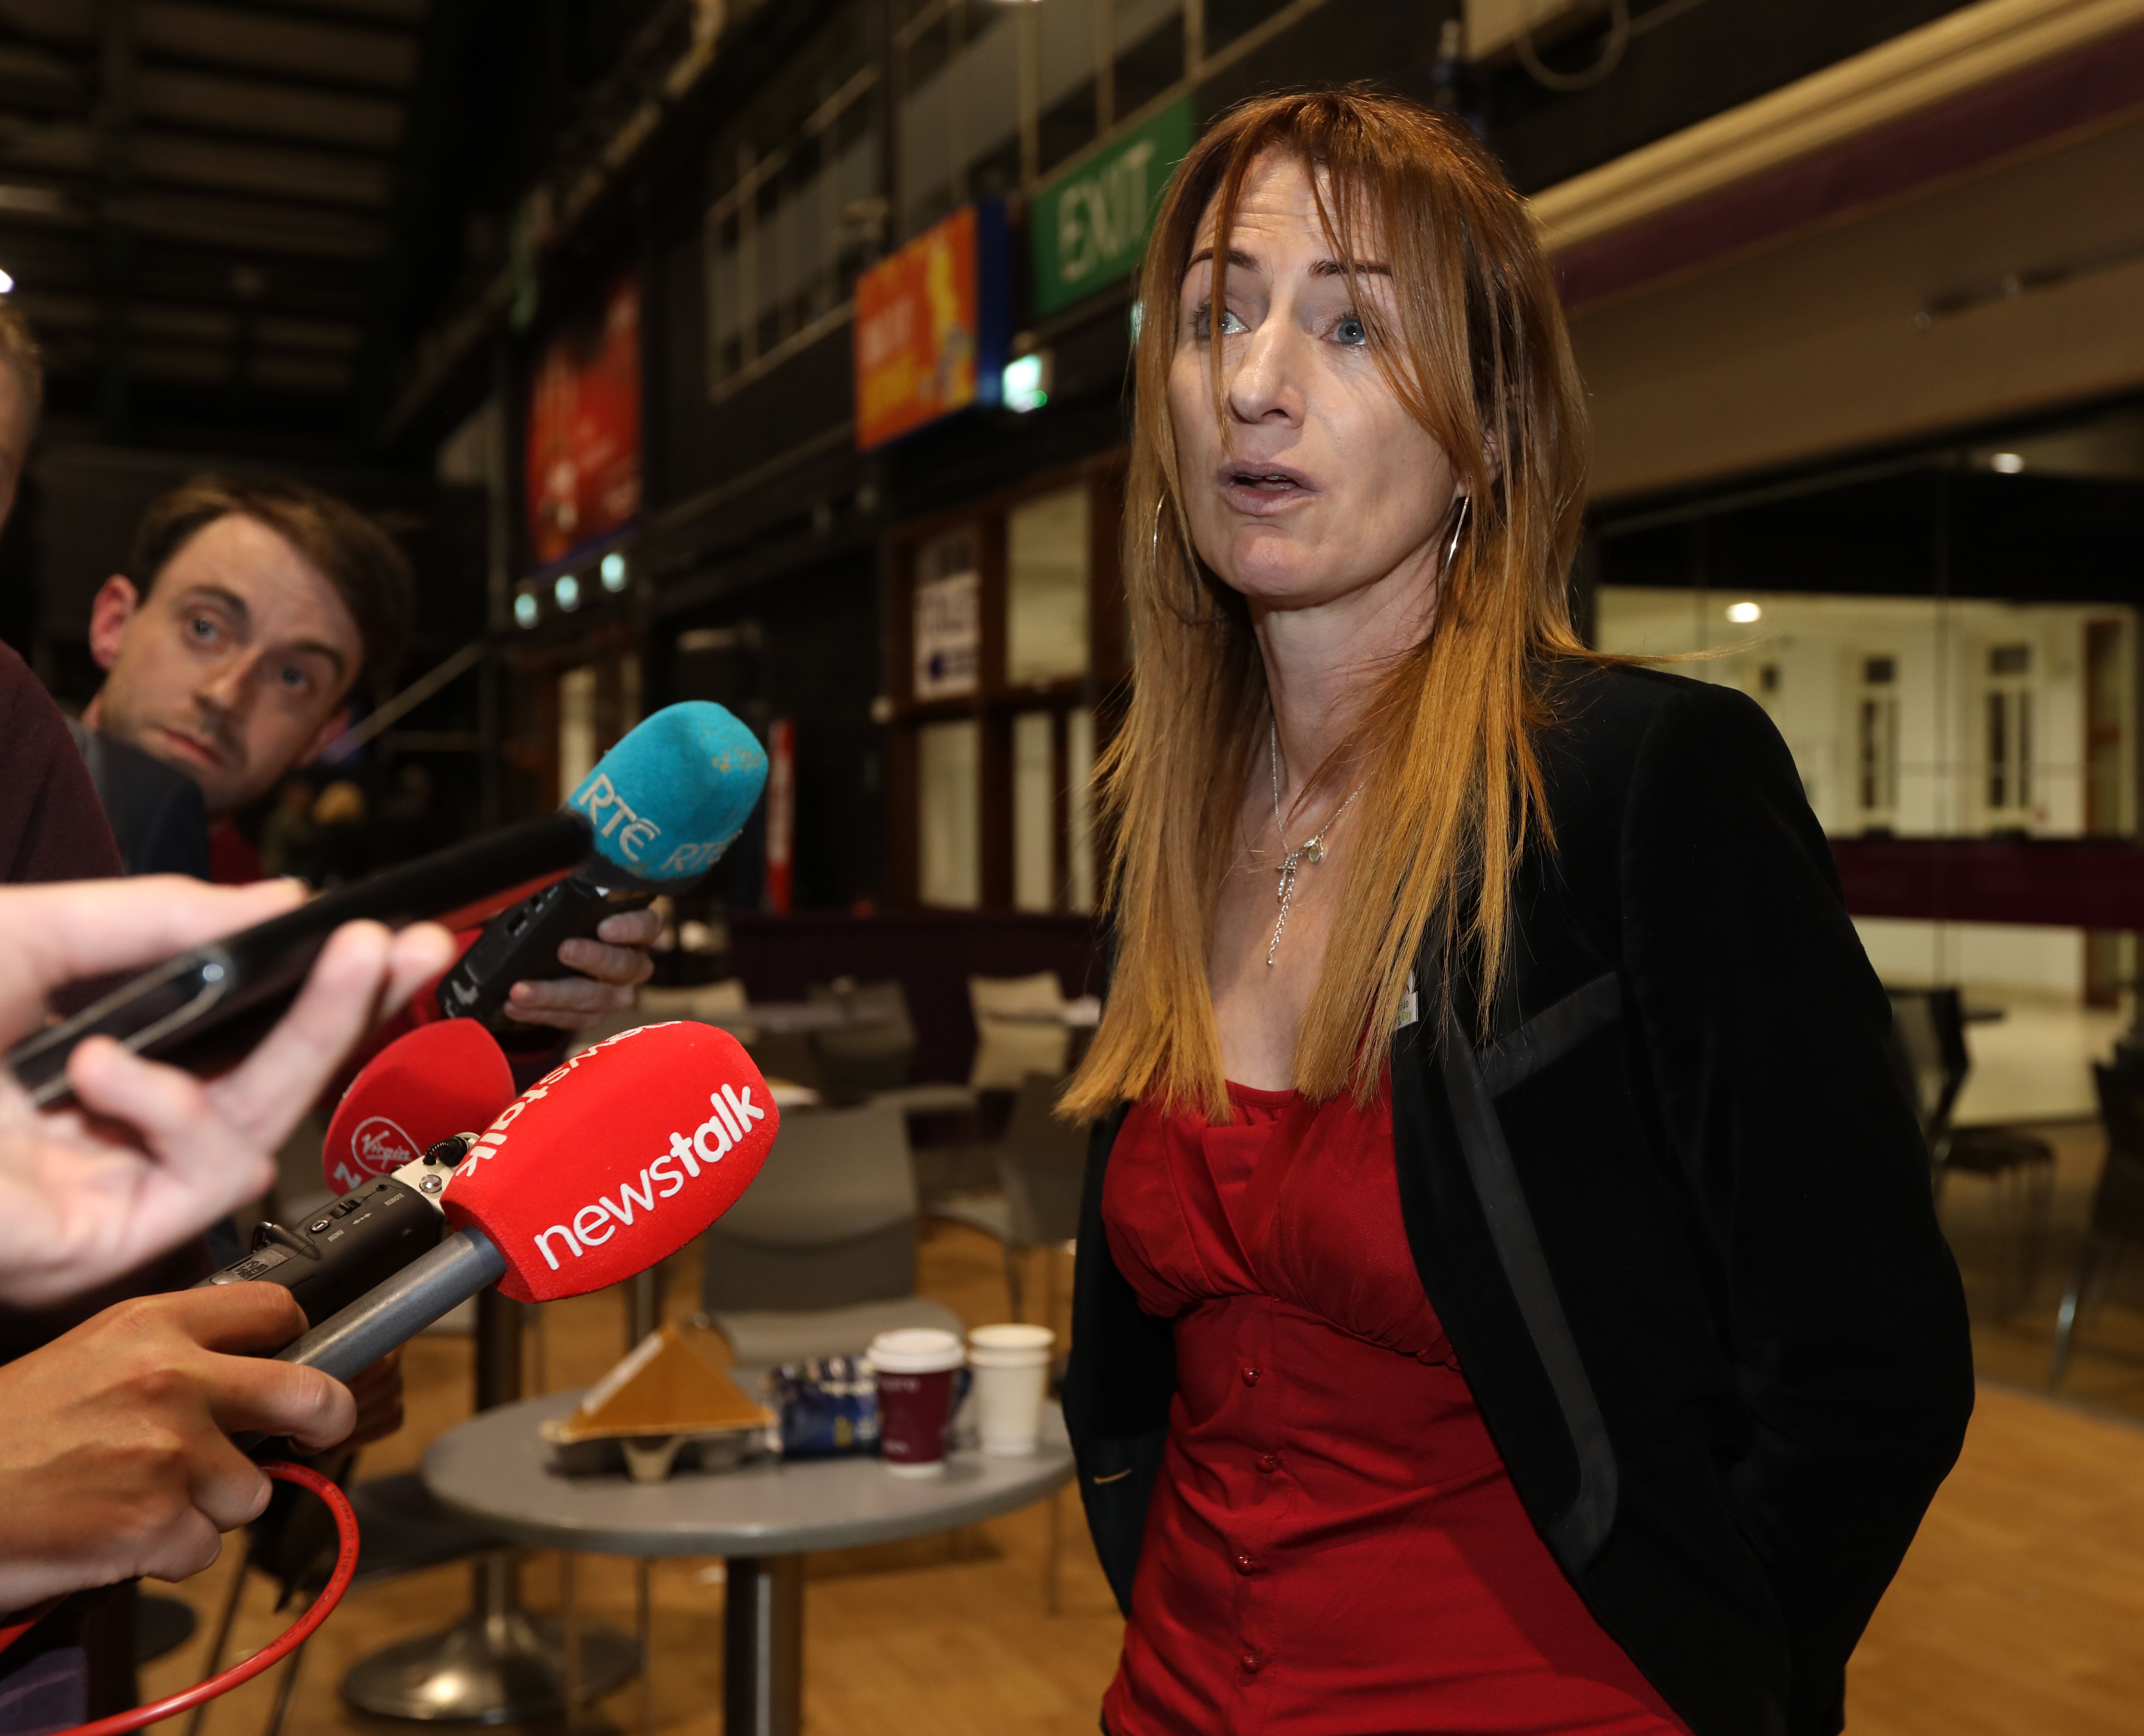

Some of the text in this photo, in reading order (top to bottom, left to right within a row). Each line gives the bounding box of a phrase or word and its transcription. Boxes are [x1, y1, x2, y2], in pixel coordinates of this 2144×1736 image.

[1059, 141, 1155, 282] EXIT
[1402, 1010, 1412, 1021] Day
[361, 1130, 412, 1170] Virgin
[534, 1083, 765, 1271] newstalk
[384, 1193, 405, 1206] REMOTE
[327, 1229, 344, 1242] MENU
